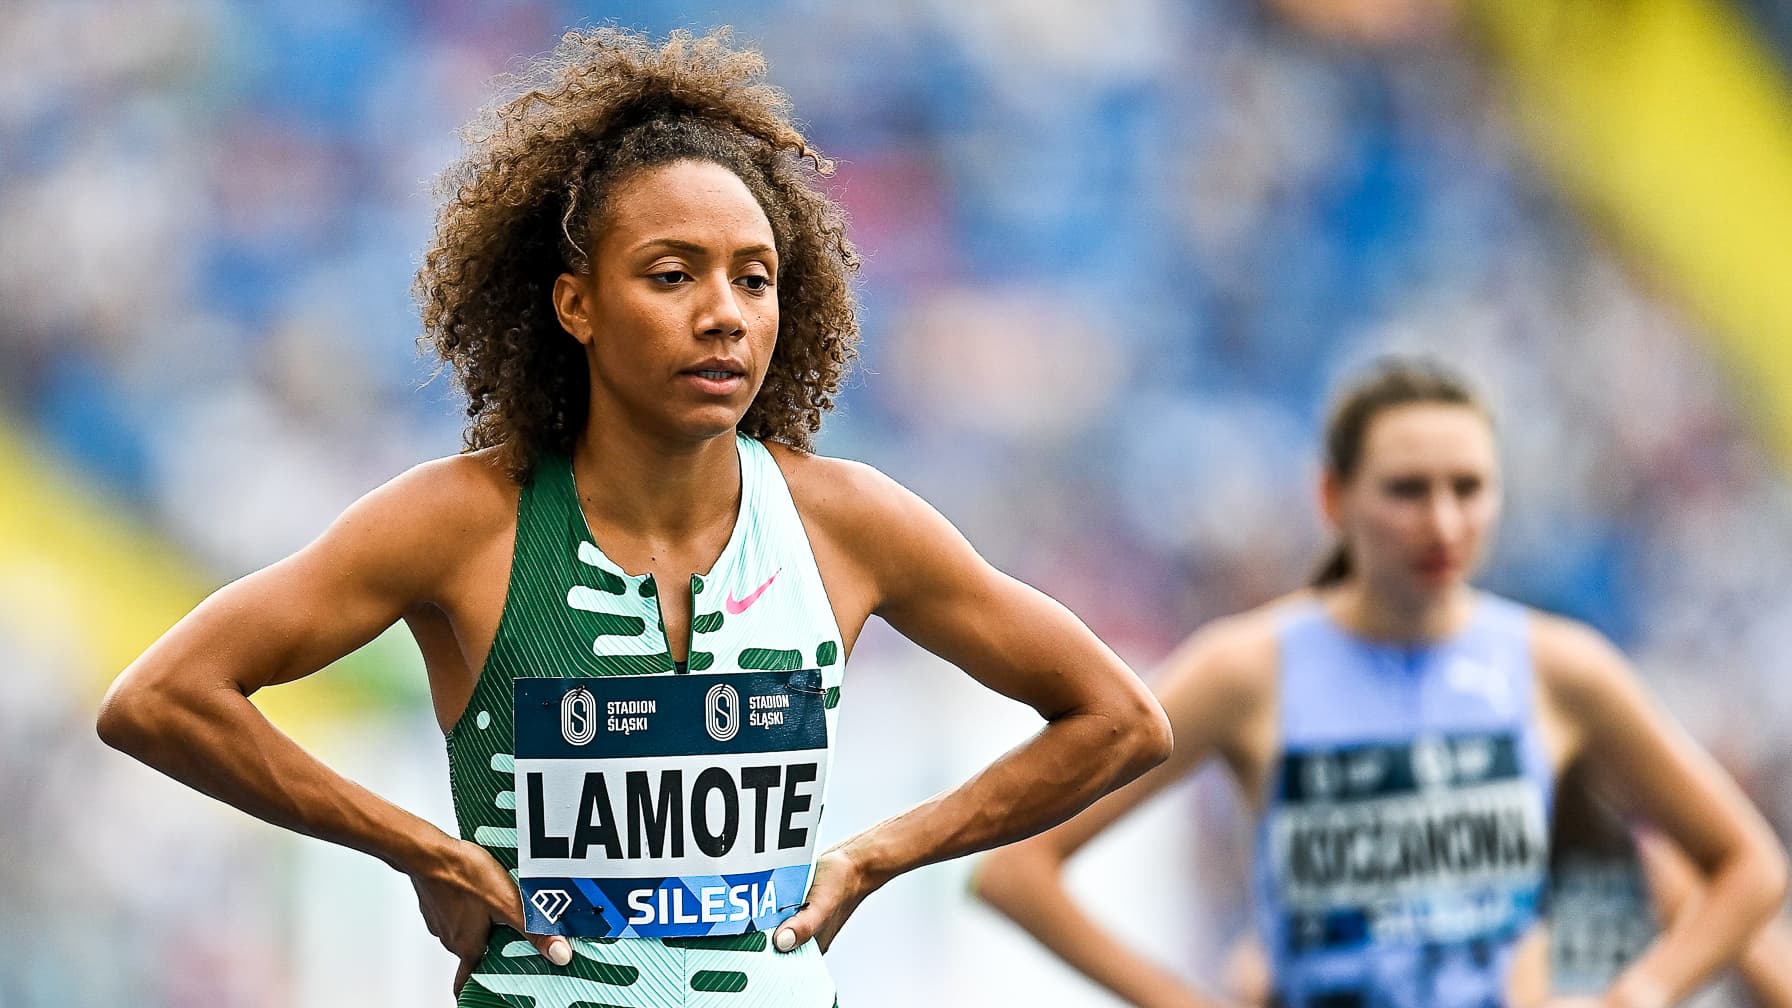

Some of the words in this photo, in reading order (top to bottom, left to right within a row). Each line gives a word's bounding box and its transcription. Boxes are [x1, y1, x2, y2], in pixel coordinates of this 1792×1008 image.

[607, 700, 656, 715] STADION
[749, 694, 789, 709] STADION
[607, 715, 648, 736] ŚLĄSKI
[749, 709, 784, 730] ŚLĄSKI
[526, 762, 818, 860] LAMOTE
[627, 880, 777, 926] SILESIA
